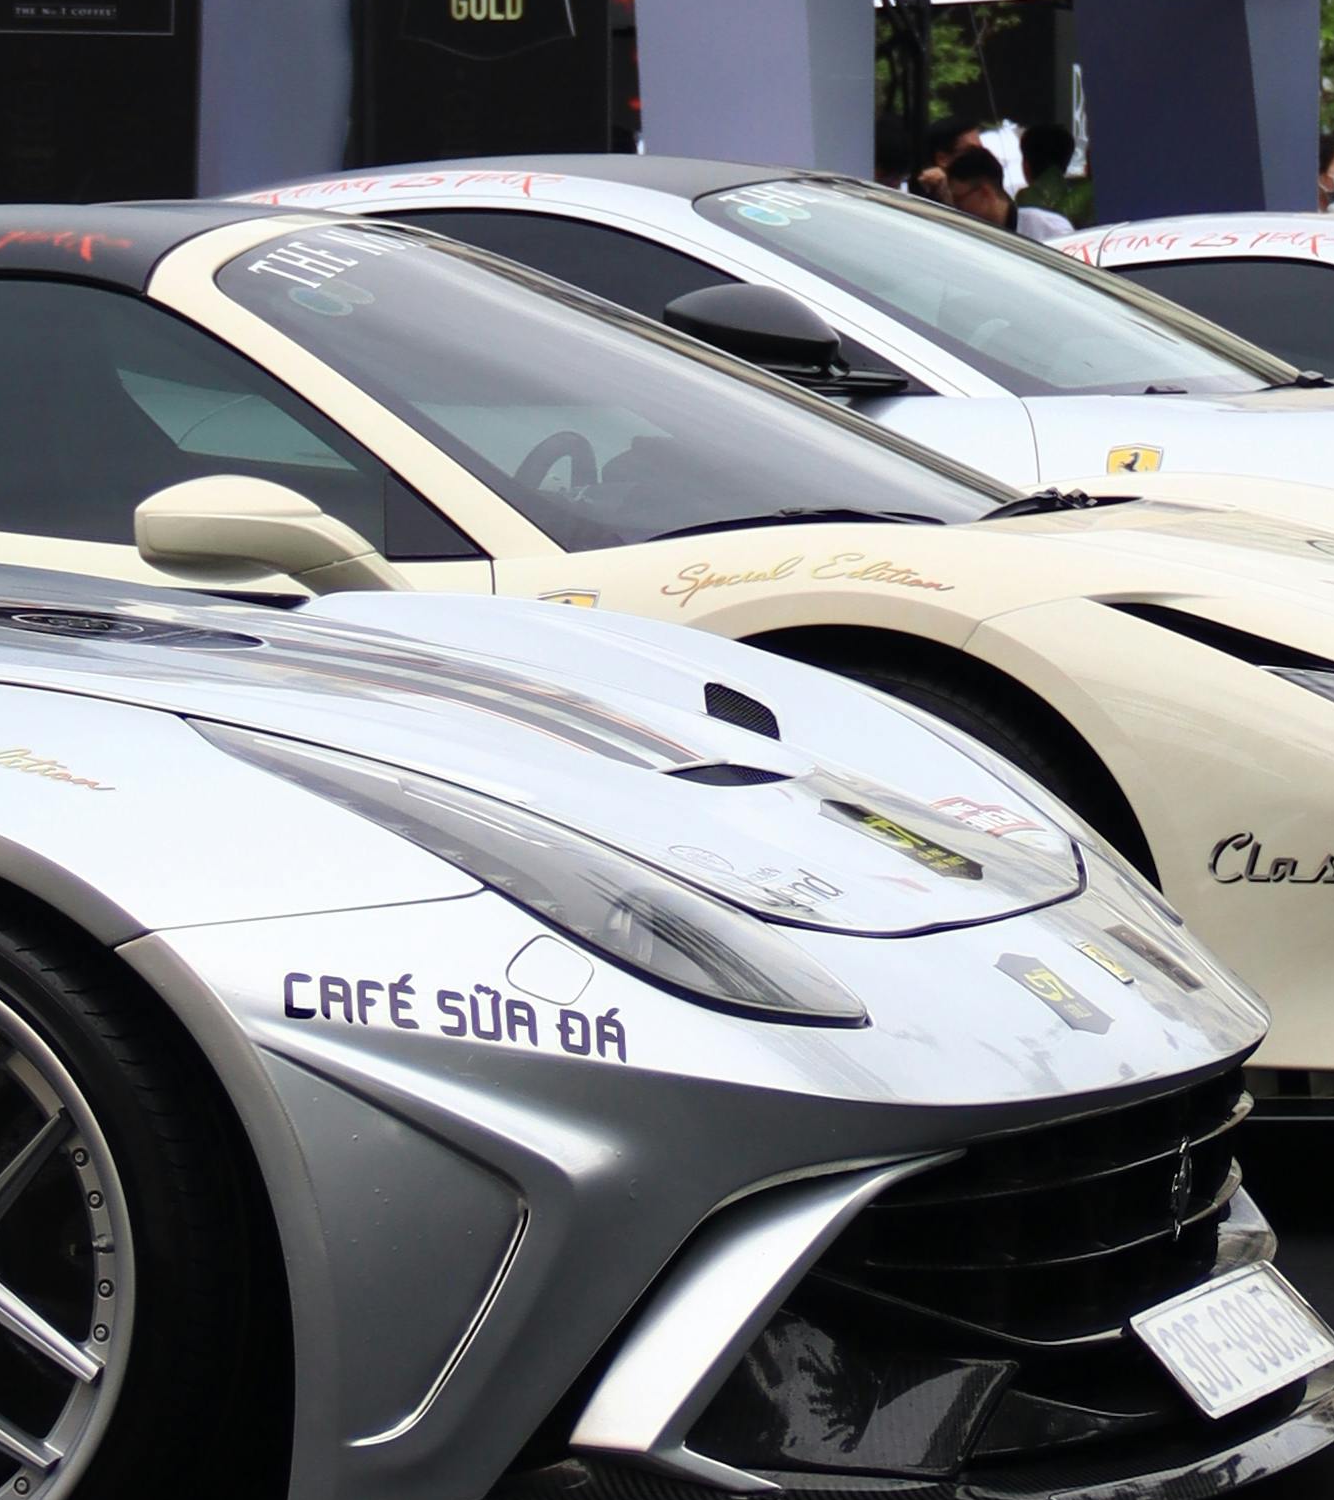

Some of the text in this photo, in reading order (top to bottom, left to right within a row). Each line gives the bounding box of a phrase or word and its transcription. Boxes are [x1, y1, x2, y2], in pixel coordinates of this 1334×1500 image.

[248, 240, 358, 289] THE
[661, 552, 955, 608] Special Edition
[284, 972, 627, 1064] CAFÉ SỮA ĐÁ
